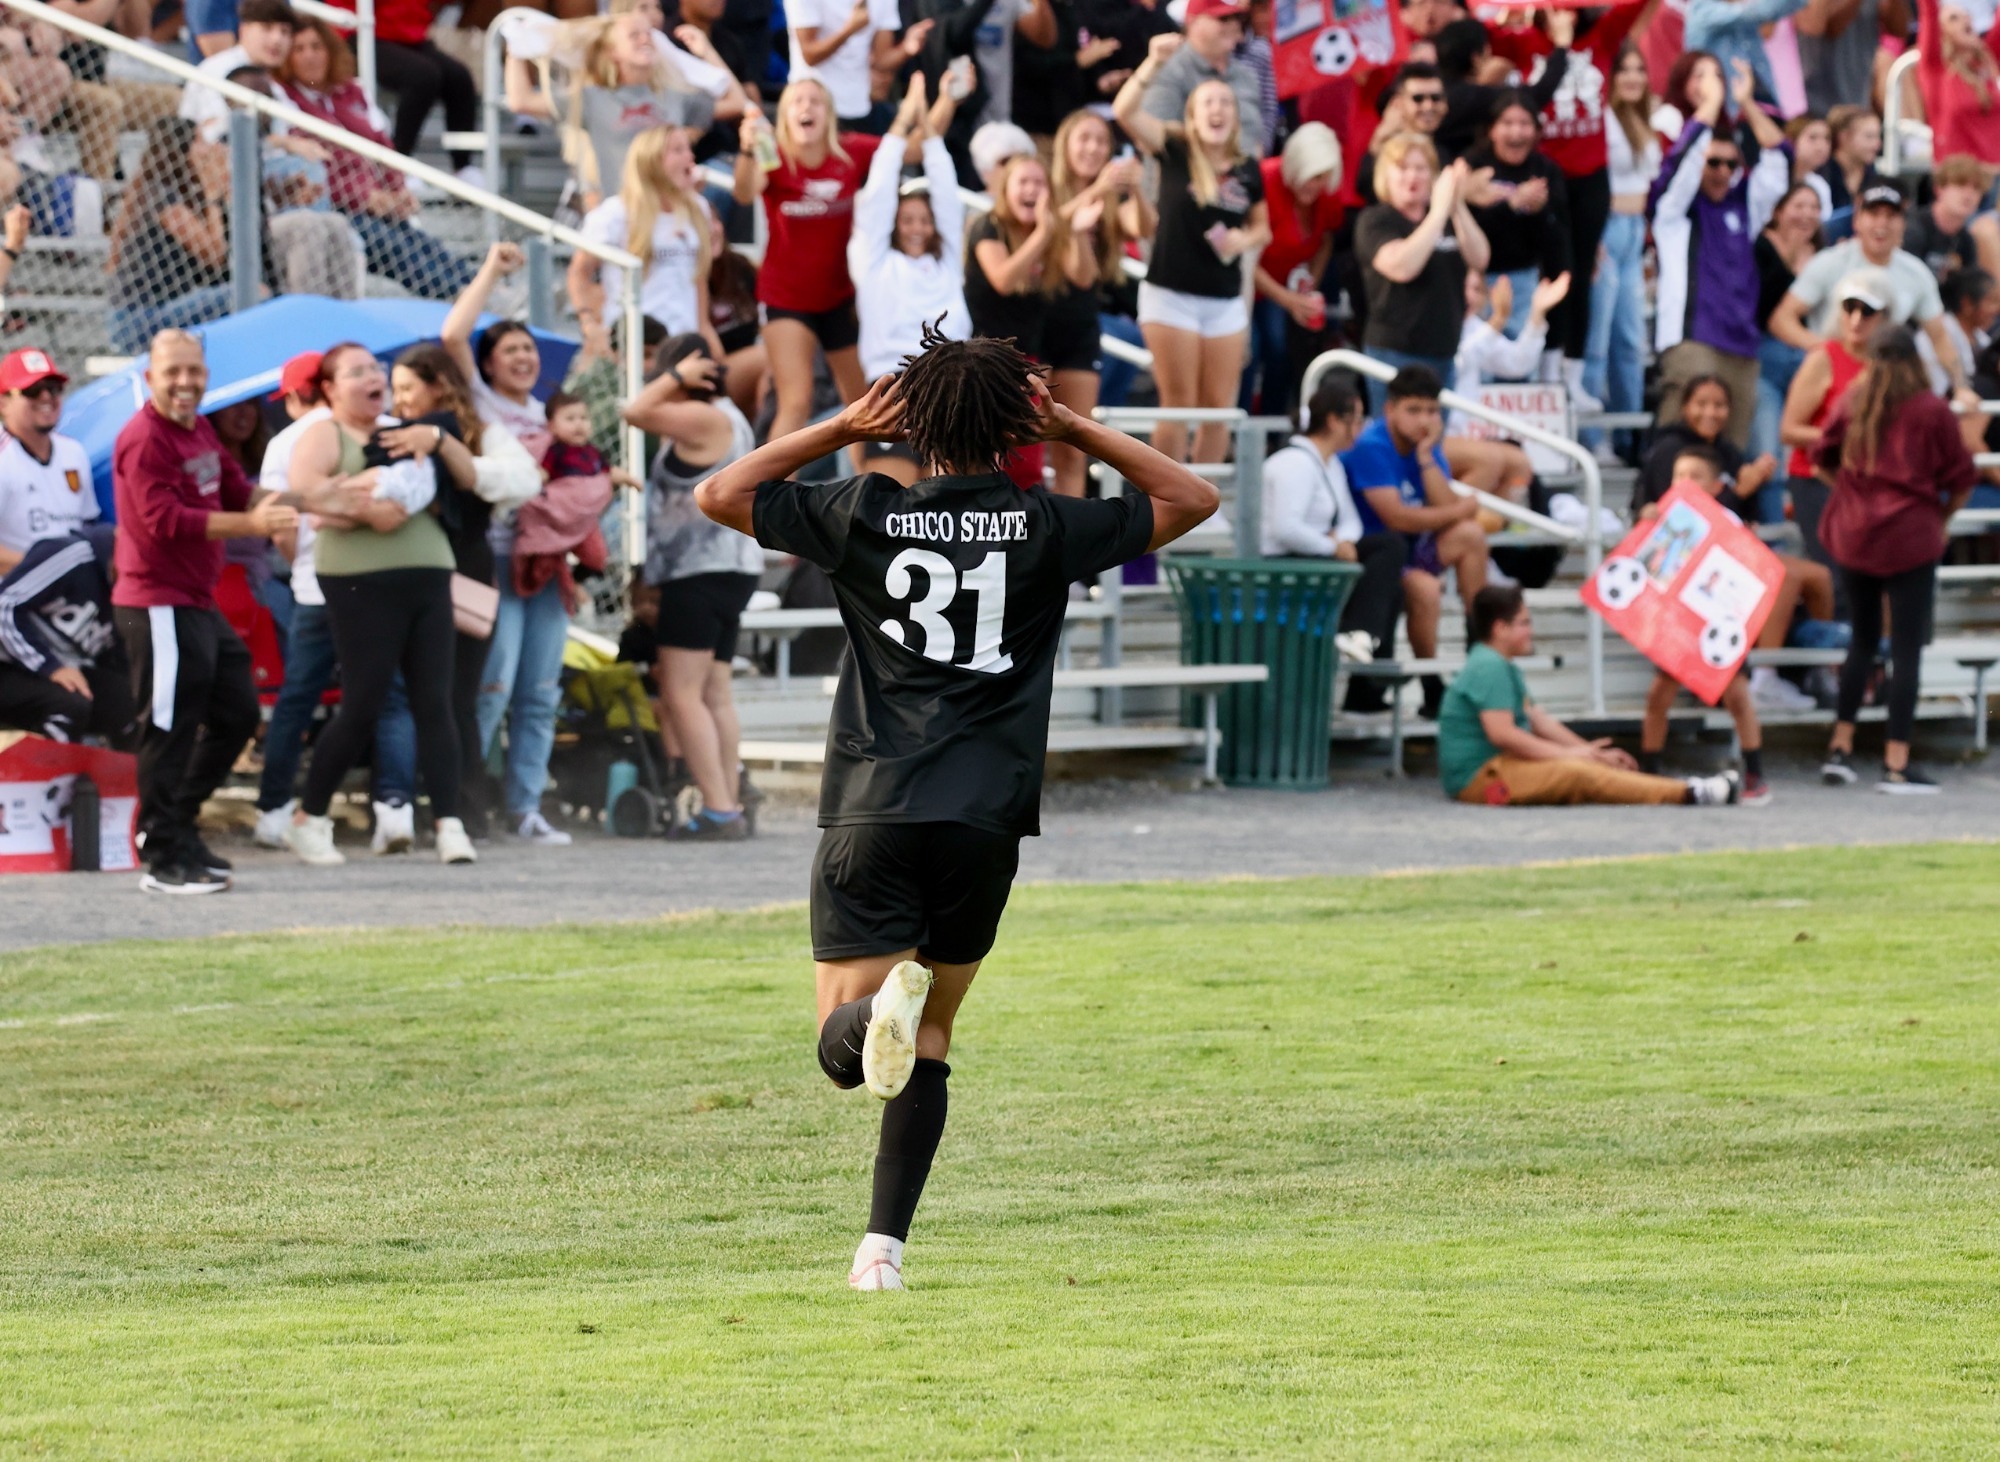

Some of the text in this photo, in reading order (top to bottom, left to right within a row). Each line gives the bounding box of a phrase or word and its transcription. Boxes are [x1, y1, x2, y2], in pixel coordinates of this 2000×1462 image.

[885, 511, 1028, 543] CHICO STATE
[879, 547, 1014, 674] 31
